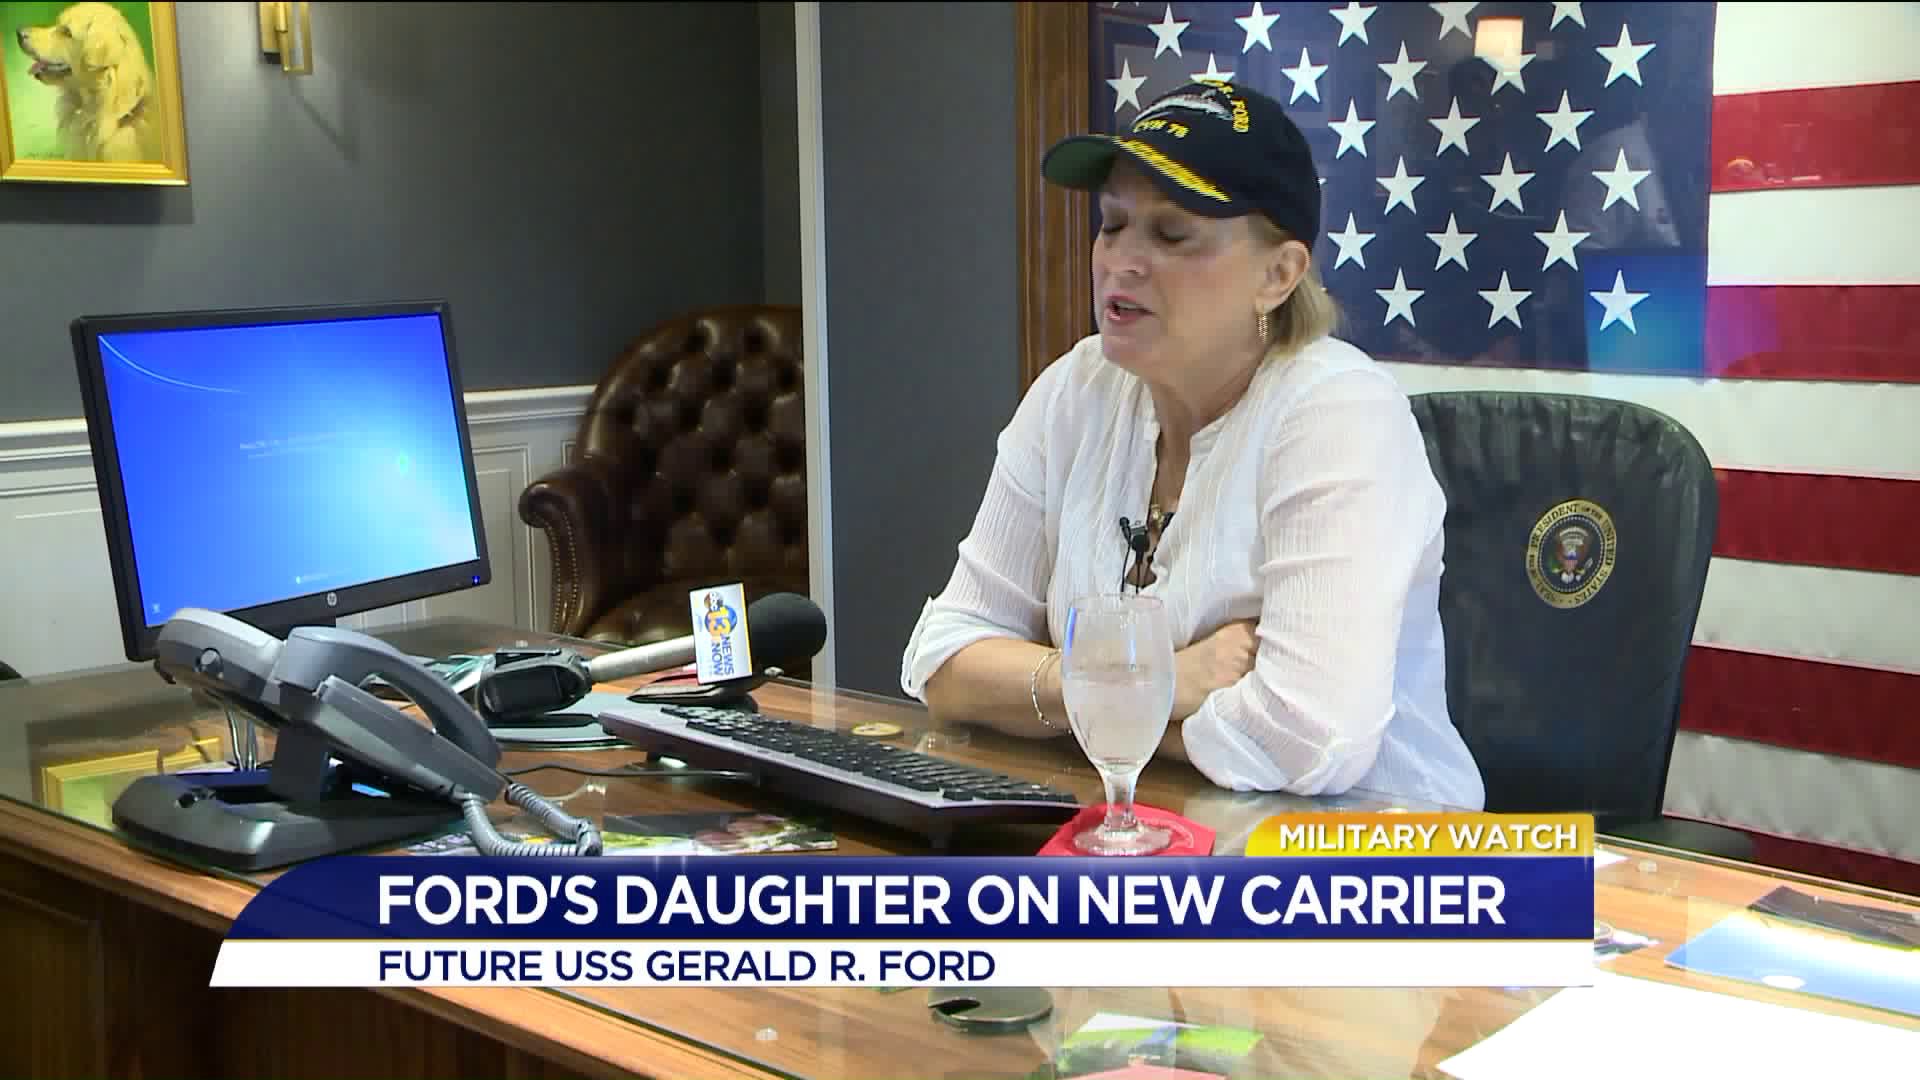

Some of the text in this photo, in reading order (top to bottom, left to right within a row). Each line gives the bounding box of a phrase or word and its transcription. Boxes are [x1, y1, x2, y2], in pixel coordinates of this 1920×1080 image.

[1231, 99, 1250, 133] FORD
[708, 607, 731, 637] 13
[711, 641, 724, 676] NOW
[720, 634, 735, 676] NEWS
